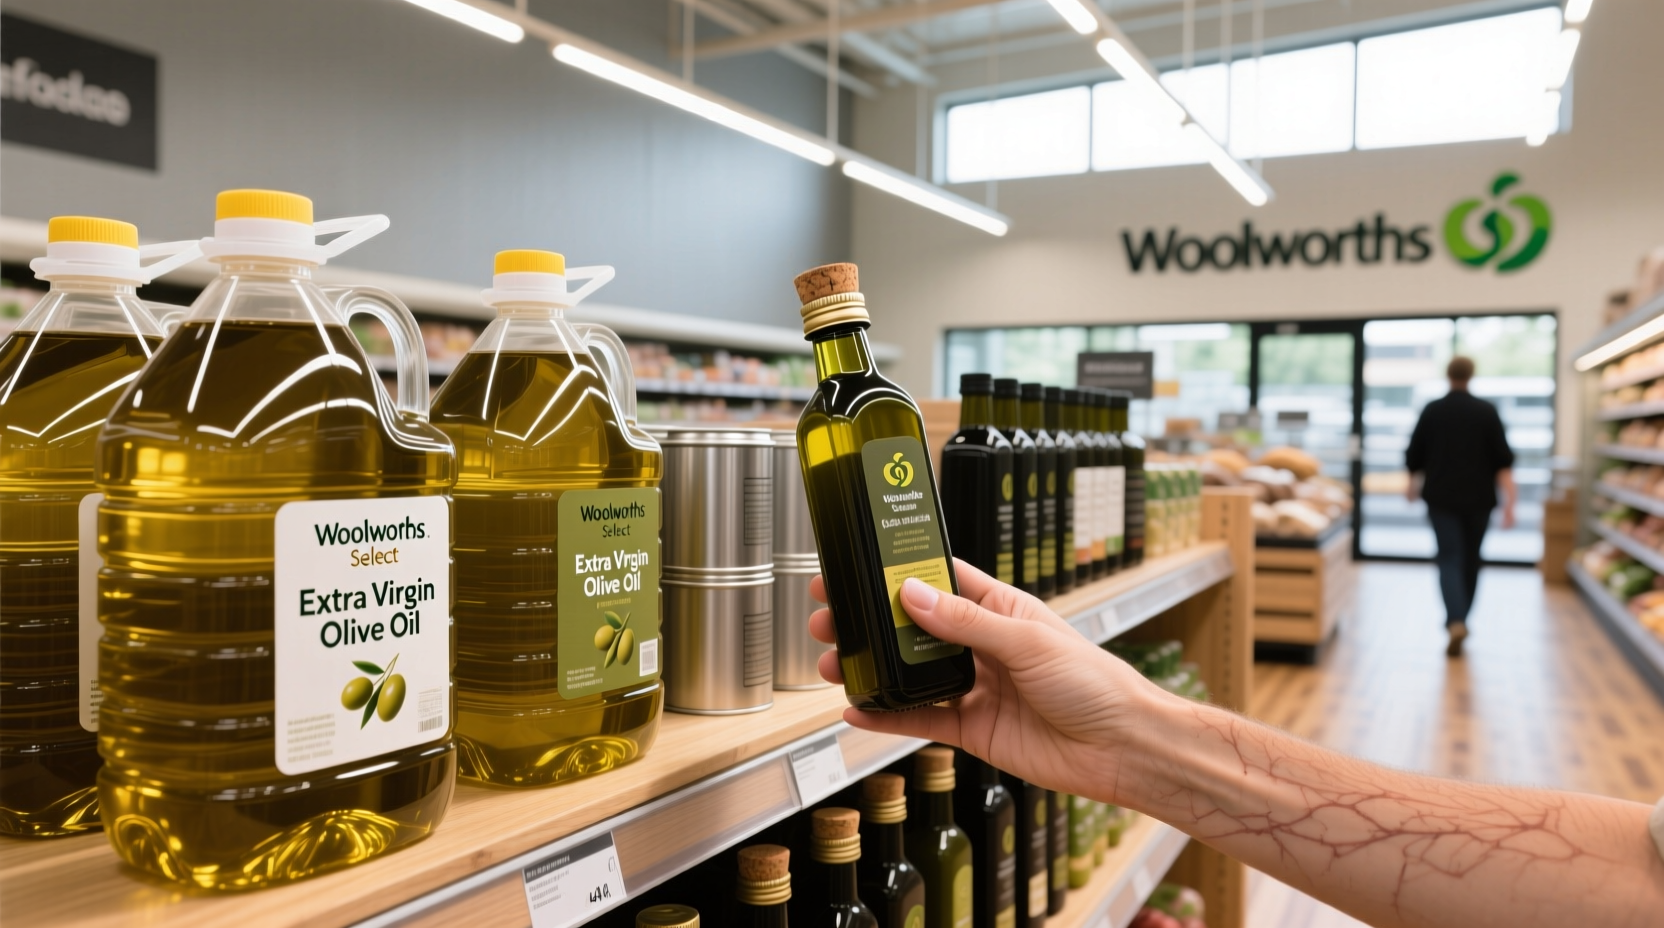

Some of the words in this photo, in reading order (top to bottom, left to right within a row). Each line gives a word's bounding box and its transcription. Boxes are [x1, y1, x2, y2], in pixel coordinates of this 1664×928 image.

[1121, 212, 1432, 274] Woolworths
[602, 523, 631, 538] Select
[350, 546, 399, 567] Select
[575, 553, 612, 575] Extra
[299, 588, 367, 616] Extra
[371, 577, 435, 610] Virgin
[584, 575, 620, 597] Olive
[320, 618, 385, 648] Olive
[390, 610, 420, 638] Oil
